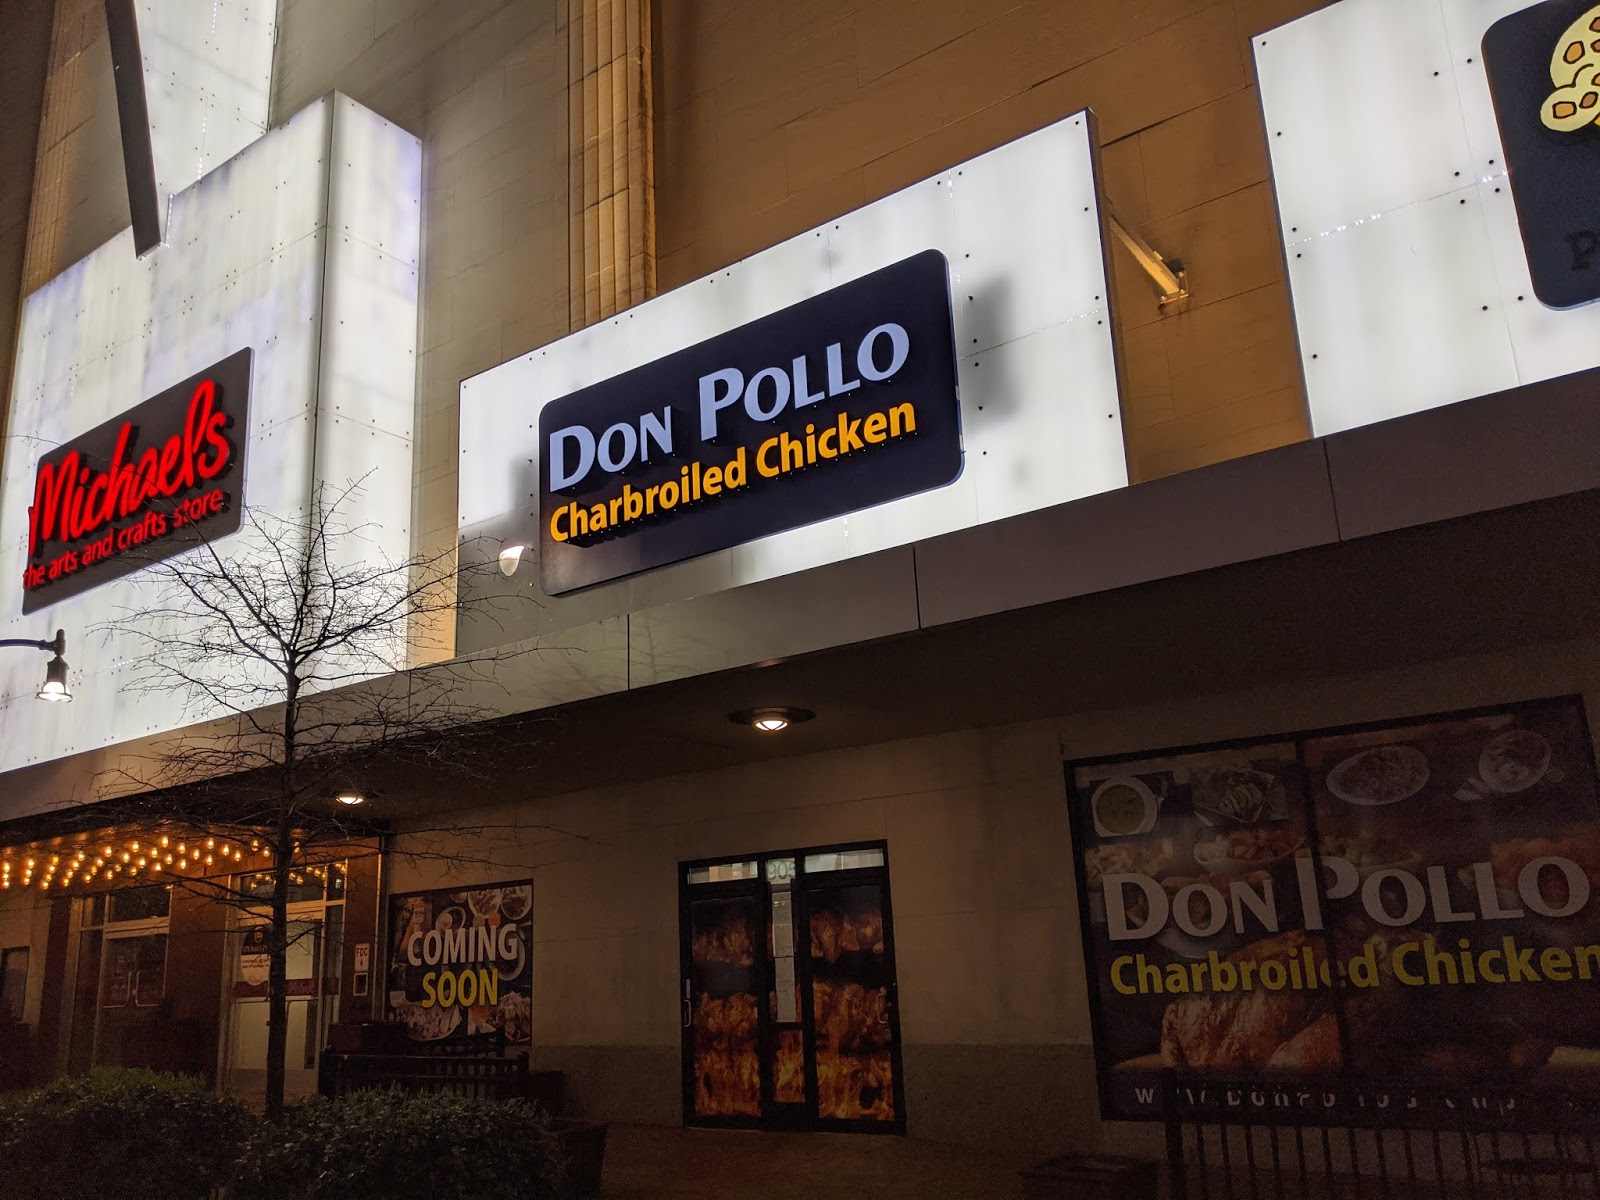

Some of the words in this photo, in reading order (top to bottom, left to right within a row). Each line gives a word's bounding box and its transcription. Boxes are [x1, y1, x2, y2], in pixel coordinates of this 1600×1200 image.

[550, 405, 673, 493] DON
[699, 322, 910, 442] POLLO
[28, 378, 229, 557] Michaels
[550, 446, 747, 543] Charbroiled
[756, 402, 917, 478] Chicken
[49, 551, 78, 580] arts
[81, 533, 114, 566] and
[117, 511, 166, 549] crafts
[173, 488, 222, 527] store
[1103, 873, 1279, 941] DON
[1296, 850, 1591, 931] POLLO
[407, 922, 518, 967] COMING
[421, 968, 498, 1008] SOON
[1110, 947, 1381, 995] Charbroiled
[1392, 933, 1600, 987] Chicken
